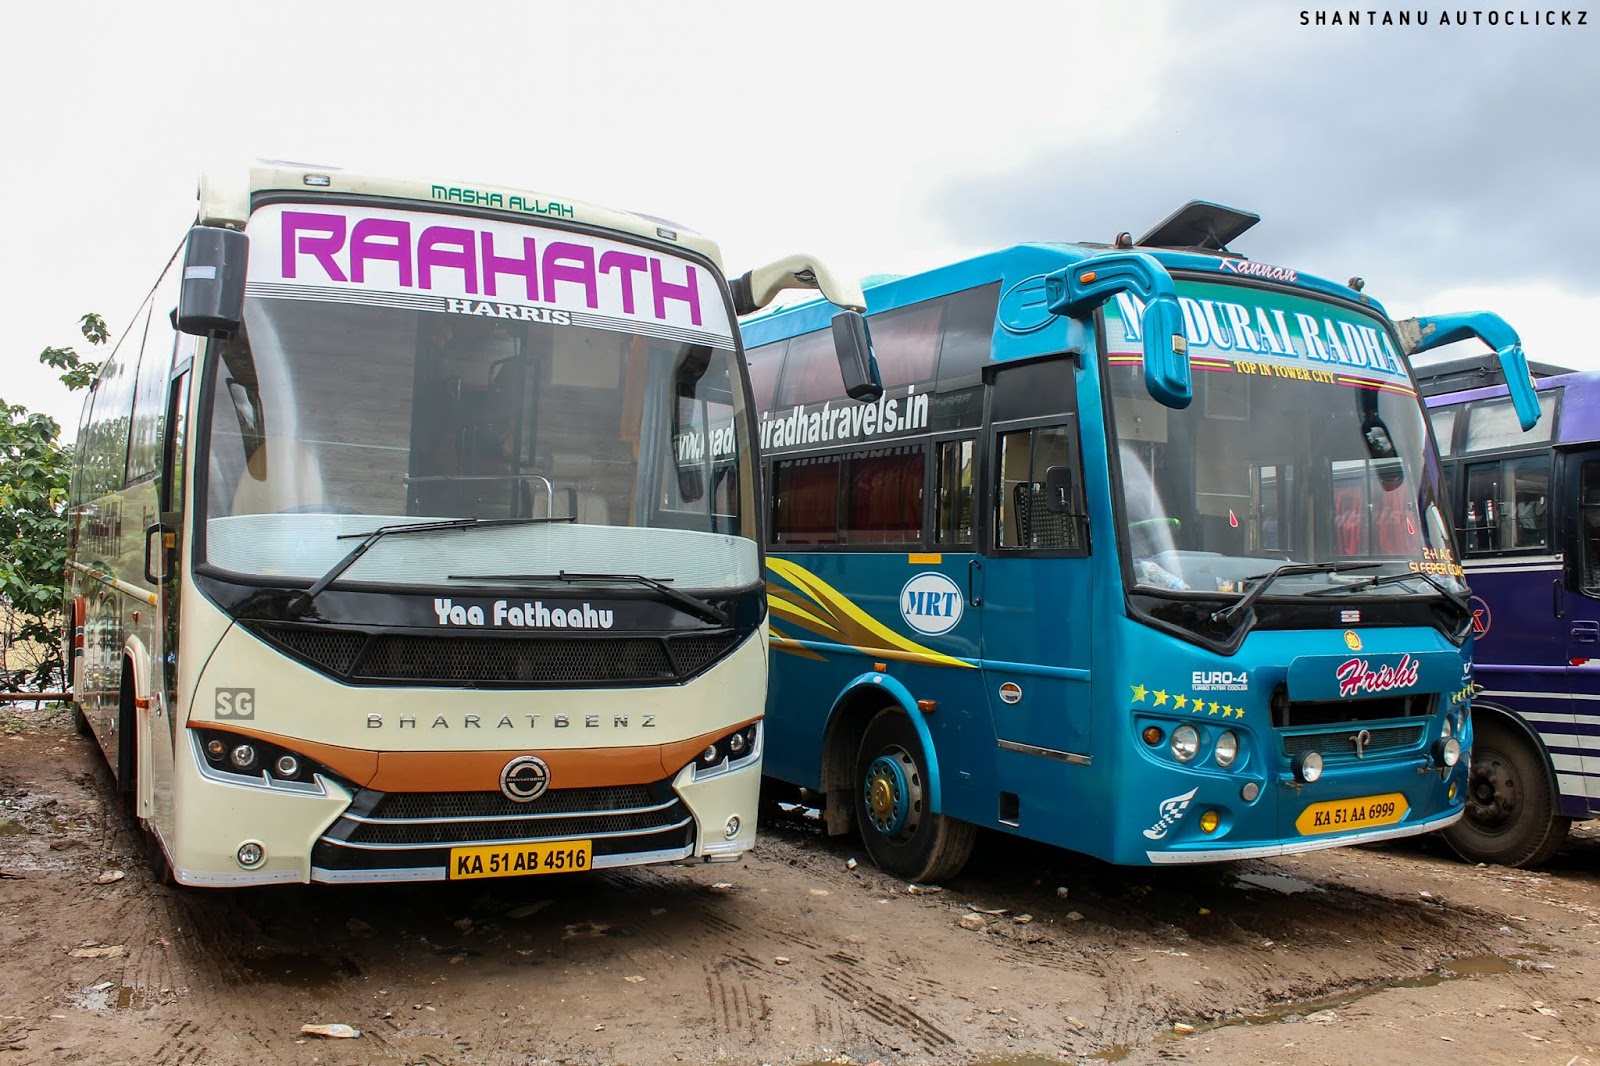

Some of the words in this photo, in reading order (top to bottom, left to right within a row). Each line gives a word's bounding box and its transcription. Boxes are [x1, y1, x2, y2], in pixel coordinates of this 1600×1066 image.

[431, 184, 503, 208] MASHA
[509, 195, 574, 219] ALLAH
[281, 210, 703, 327] RAAHATH
[1218, 256, 1297, 282] Kannan
[446, 298, 571, 326] HARRIS
[1113, 291, 1299, 359] MDURAI
[1293, 311, 1407, 378] RADHA
[1233, 360, 1257, 375] TOP
[1258, 362, 1272, 376] IN
[1272, 364, 1312, 381] TOWER
[1311, 369, 1336, 384] CITY
[1408, 561, 1448, 575] SLEEPER
[434, 598, 485, 626] Yaa
[493, 600, 613, 629] Fathaahu
[905, 591, 958, 618] MRT
[1192, 671, 1249, 684] EURO-4
[1336, 653, 1419, 697] Hrishi
[216, 691, 253, 716] SG
[366, 713, 657, 729] BHARATBENZ
[1313, 811, 1331, 827] KA
[1334, 808, 1347, 824] 51
[1350, 806, 1366, 822] AA
[1368, 802, 1395, 819] 6999
[457, 855, 484, 875] KA
[489, 852, 509, 872] 51
[513, 851, 538, 871] AB
[544, 849, 586, 869] 4516
